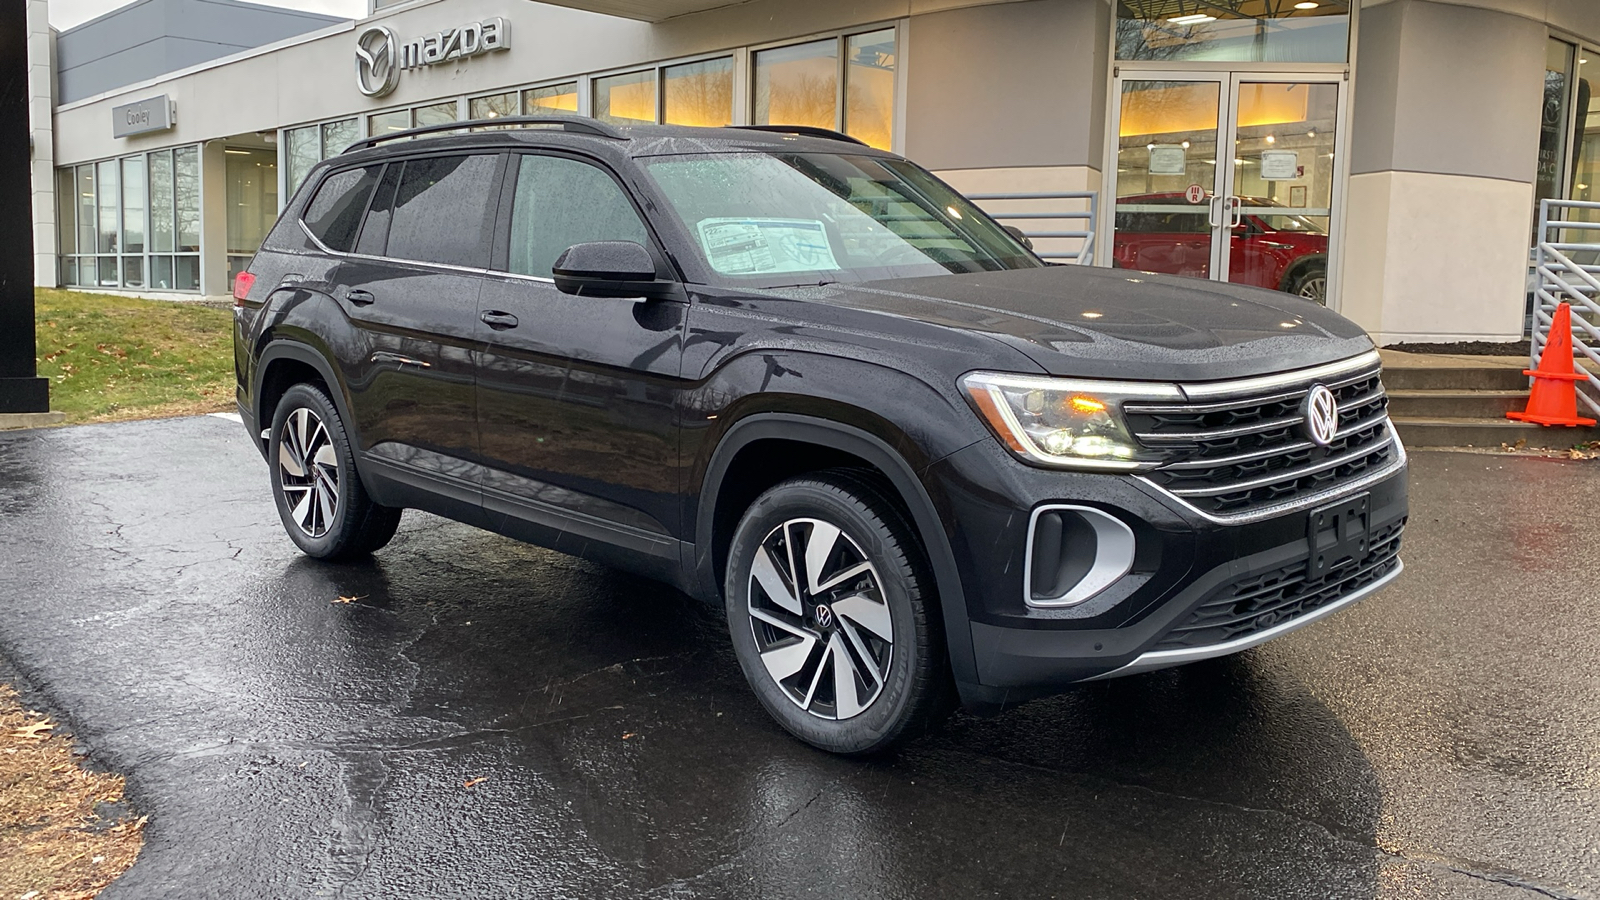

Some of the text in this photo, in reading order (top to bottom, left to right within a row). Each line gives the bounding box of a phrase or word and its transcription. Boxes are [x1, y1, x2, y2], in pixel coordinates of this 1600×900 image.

[400, 16, 510, 70] mazda
[126, 103, 150, 126] Cooley
[1191, 194, 1198, 202] R
[728, 541, 743, 612] NEXEN
